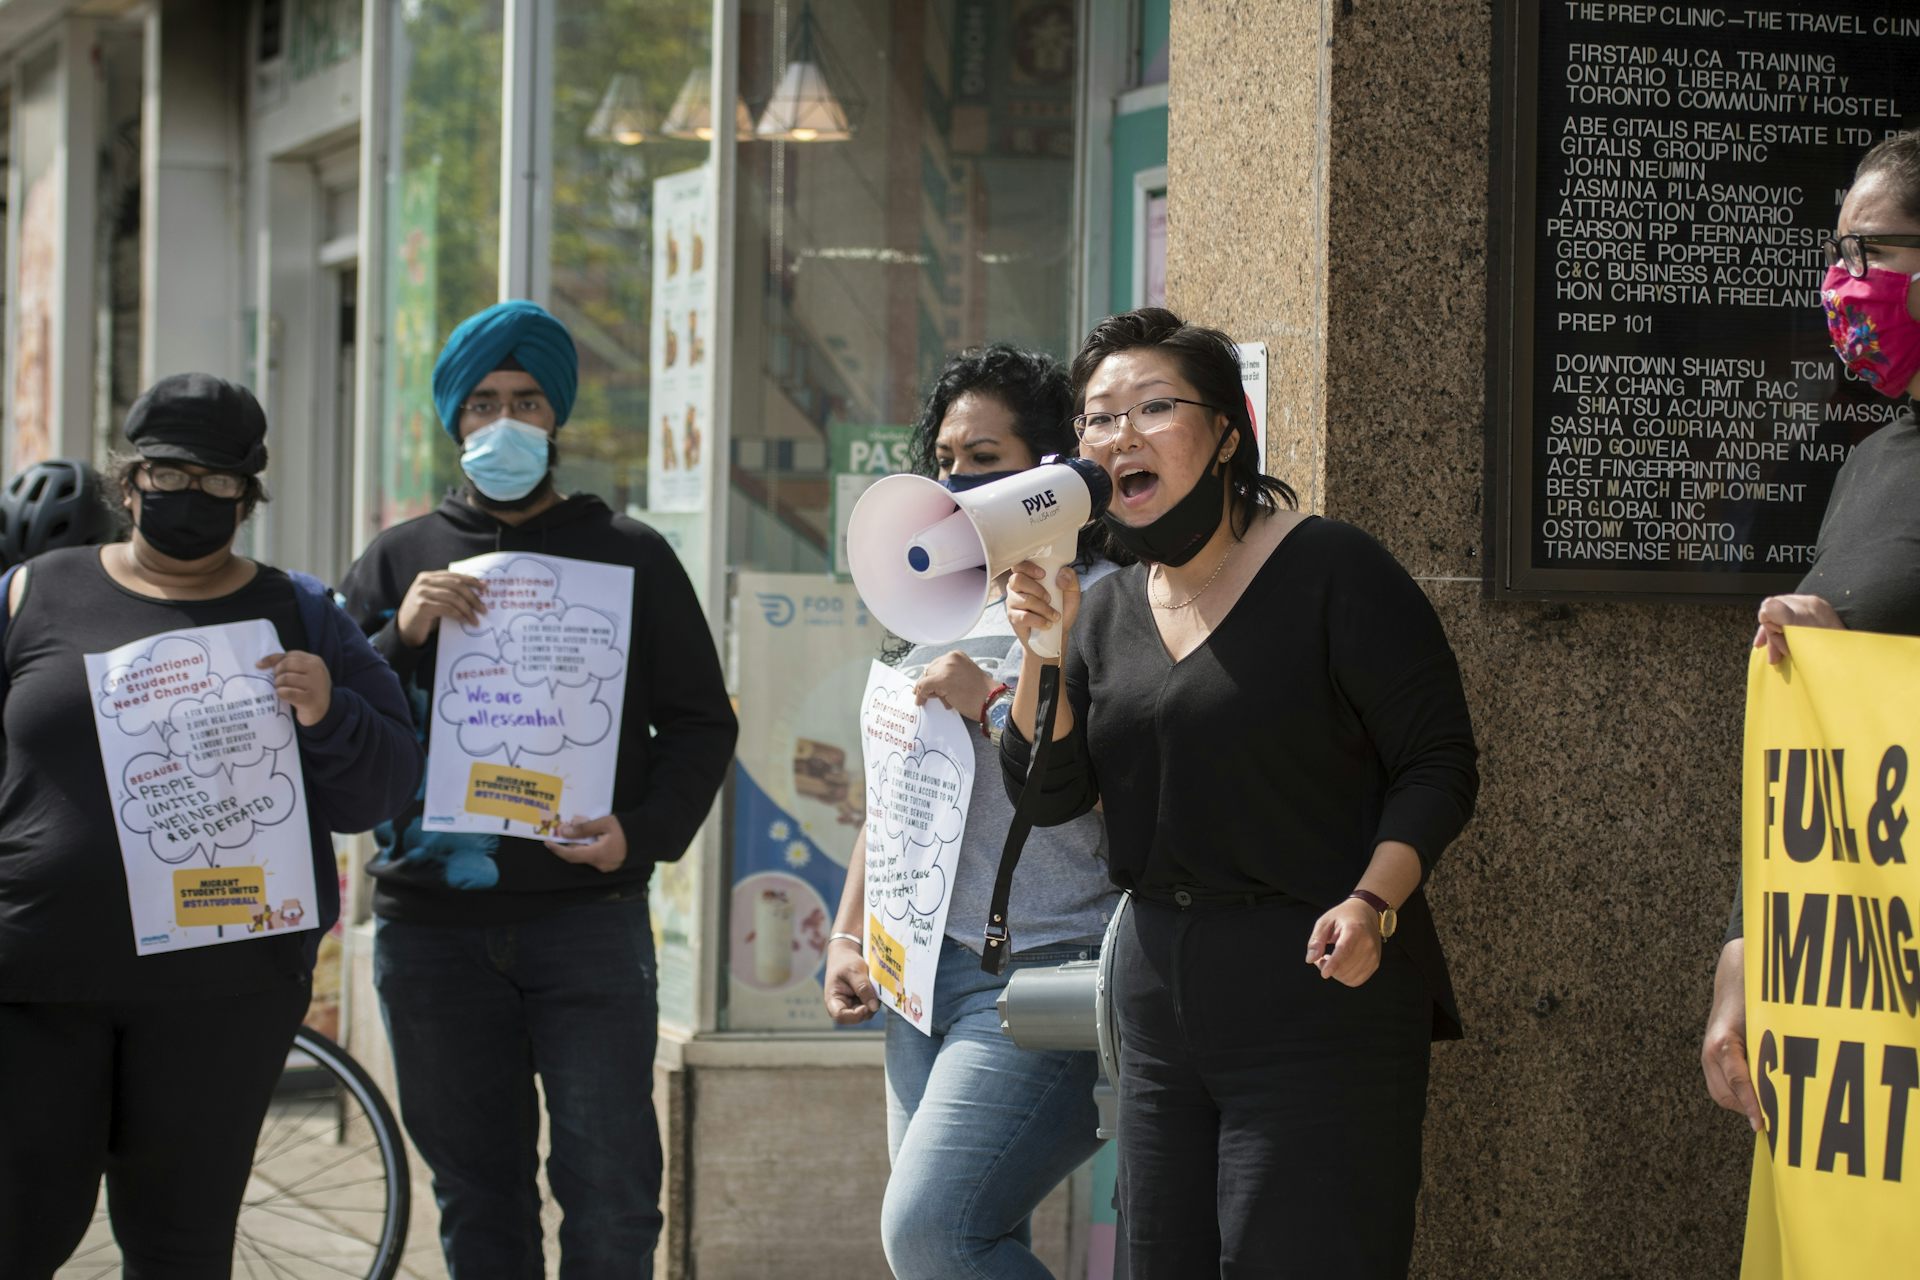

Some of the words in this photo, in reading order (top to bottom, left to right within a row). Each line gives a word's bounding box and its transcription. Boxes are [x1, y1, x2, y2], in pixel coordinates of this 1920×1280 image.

[1565, 2, 1604, 21] THE
[1608, 3, 1657, 23] PREP
[1786, 12, 1867, 35] TRAVEL
[1662, 48, 1723, 69] 4U.CA
[1737, 51, 1836, 74] TRAINING
[1566, 63, 1666, 87] ONTARIO
[1678, 69, 1767, 91] LIBERAL
[1778, 73, 1849, 94] PARTY
[1566, 84, 1671, 108] TORONTO
[1678, 89, 1808, 112] COMMUNITY
[1813, 95, 1902, 118] HOSTEL
[1563, 116, 1608, 136] ABE
[1612, 117, 1688, 139] GITALIS
[1693, 121, 1745, 141] REAL
[1750, 123, 1828, 145] ESTATE
[1837, 127, 1872, 147] LTD
[1560, 136, 1642, 158] GITALIS
[1653, 140, 1729, 161] GROUP
[1732, 143, 1768, 163] INC
[1564, 157, 1621, 177] JOHN
[1630, 159, 1706, 181] NEUMIN
[1559, 178, 1657, 200] JASMINA
[1668, 181, 1804, 205] PILASANOVIC
[1559, 198, 1695, 222] ATTRACTION
[1707, 204, 1794, 225] ONTARIO
[1547, 218, 1642, 240] PEARSON
[1649, 222, 1677, 241] RP
[1691, 224, 1814, 247] FERNANDES
[1557, 240, 1646, 261] GEORGE
[1658, 244, 1740, 264] POPPER
[1749, 247, 1828, 268] ARCHIT
[1555, 260, 1600, 280] C&C
[1608, 262, 1708, 284] BUSINESS
[1557, 281, 1602, 301] HON
[1611, 283, 1711, 305] CHRYSTIA
[1718, 287, 1824, 308] FREELAND
[1558, 312, 1617, 332] PREP
[1623, 314, 1652, 334] 101
[1556, 354, 1675, 376] DOWNTOWN
[1682, 357, 1765, 379] SHIATSU
[1791, 361, 1834, 381] TCM
[1552, 375, 1609, 394] ALEX
[1615, 376, 1685, 396] CHANG
[1701, 379, 1744, 398] RMT
[1756, 381, 1798, 399] RAC
[1577, 395, 1660, 416] SHIATSU
[1667, 398, 1819, 421] ACUPUNCTURE
[1550, 416, 1624, 436] SASHA
[1633, 418, 1755, 439] GOUDRIAAN
[1773, 422, 1820, 441] RMT
[1547, 436, 1602, 456] DAVID
[1609, 437, 1690, 458] GOUVEIA
[1716, 441, 1789, 461] ANDRE
[1547, 457, 1593, 477] ACE
[1600, 458, 1761, 481] FINGERPRINTING
[1021, 489, 1057, 516] PYLE
[1547, 478, 1603, 498] BEST
[1607, 479, 1670, 499] MATCH
[1681, 481, 1807, 502] EMPLOYMENT
[1548, 499, 1583, 518] LPR
[1588, 500, 1662, 519] GLOBAL
[1671, 501, 1705, 521] INC
[1542, 519, 1624, 539] OSTOMY
[1633, 521, 1735, 542] TORONTO
[1544, 540, 1670, 561] TRANSENSE
[1677, 543, 1755, 562] HEALING
[1766, 545, 1818, 564] ARTS
[111, 654, 204, 687] International
[126, 671, 189, 694] Students
[113, 692, 150, 711] Need
[154, 678, 212, 699] Change!
[465, 684, 492, 704] We
[495, 692, 522, 705] are
[872, 698, 917, 724] International
[875, 714, 905, 734] Students
[884, 731, 917, 752] Change!
[919, 786, 938, 799] ACCESS
[920, 774, 940, 787] AROUND
[942, 779, 957, 791] WORK
[146, 790, 210, 818] UNITED
[188, 796, 239, 821] NEVER
[910, 795, 931, 808] TUITION
[910, 807, 934, 821] SERVICES
[1764, 748, 1861, 864] FULL
[1867, 744, 1909, 867] &
[203, 796, 274, 837] DEFEATED
[905, 816, 928, 831] FAMILIES
[180, 887, 227, 898] STUDENTS
[228, 885, 260, 895] UNITED
[200, 878, 239, 887] MIGRANT
[1757, 1029, 1920, 1183] STAT
